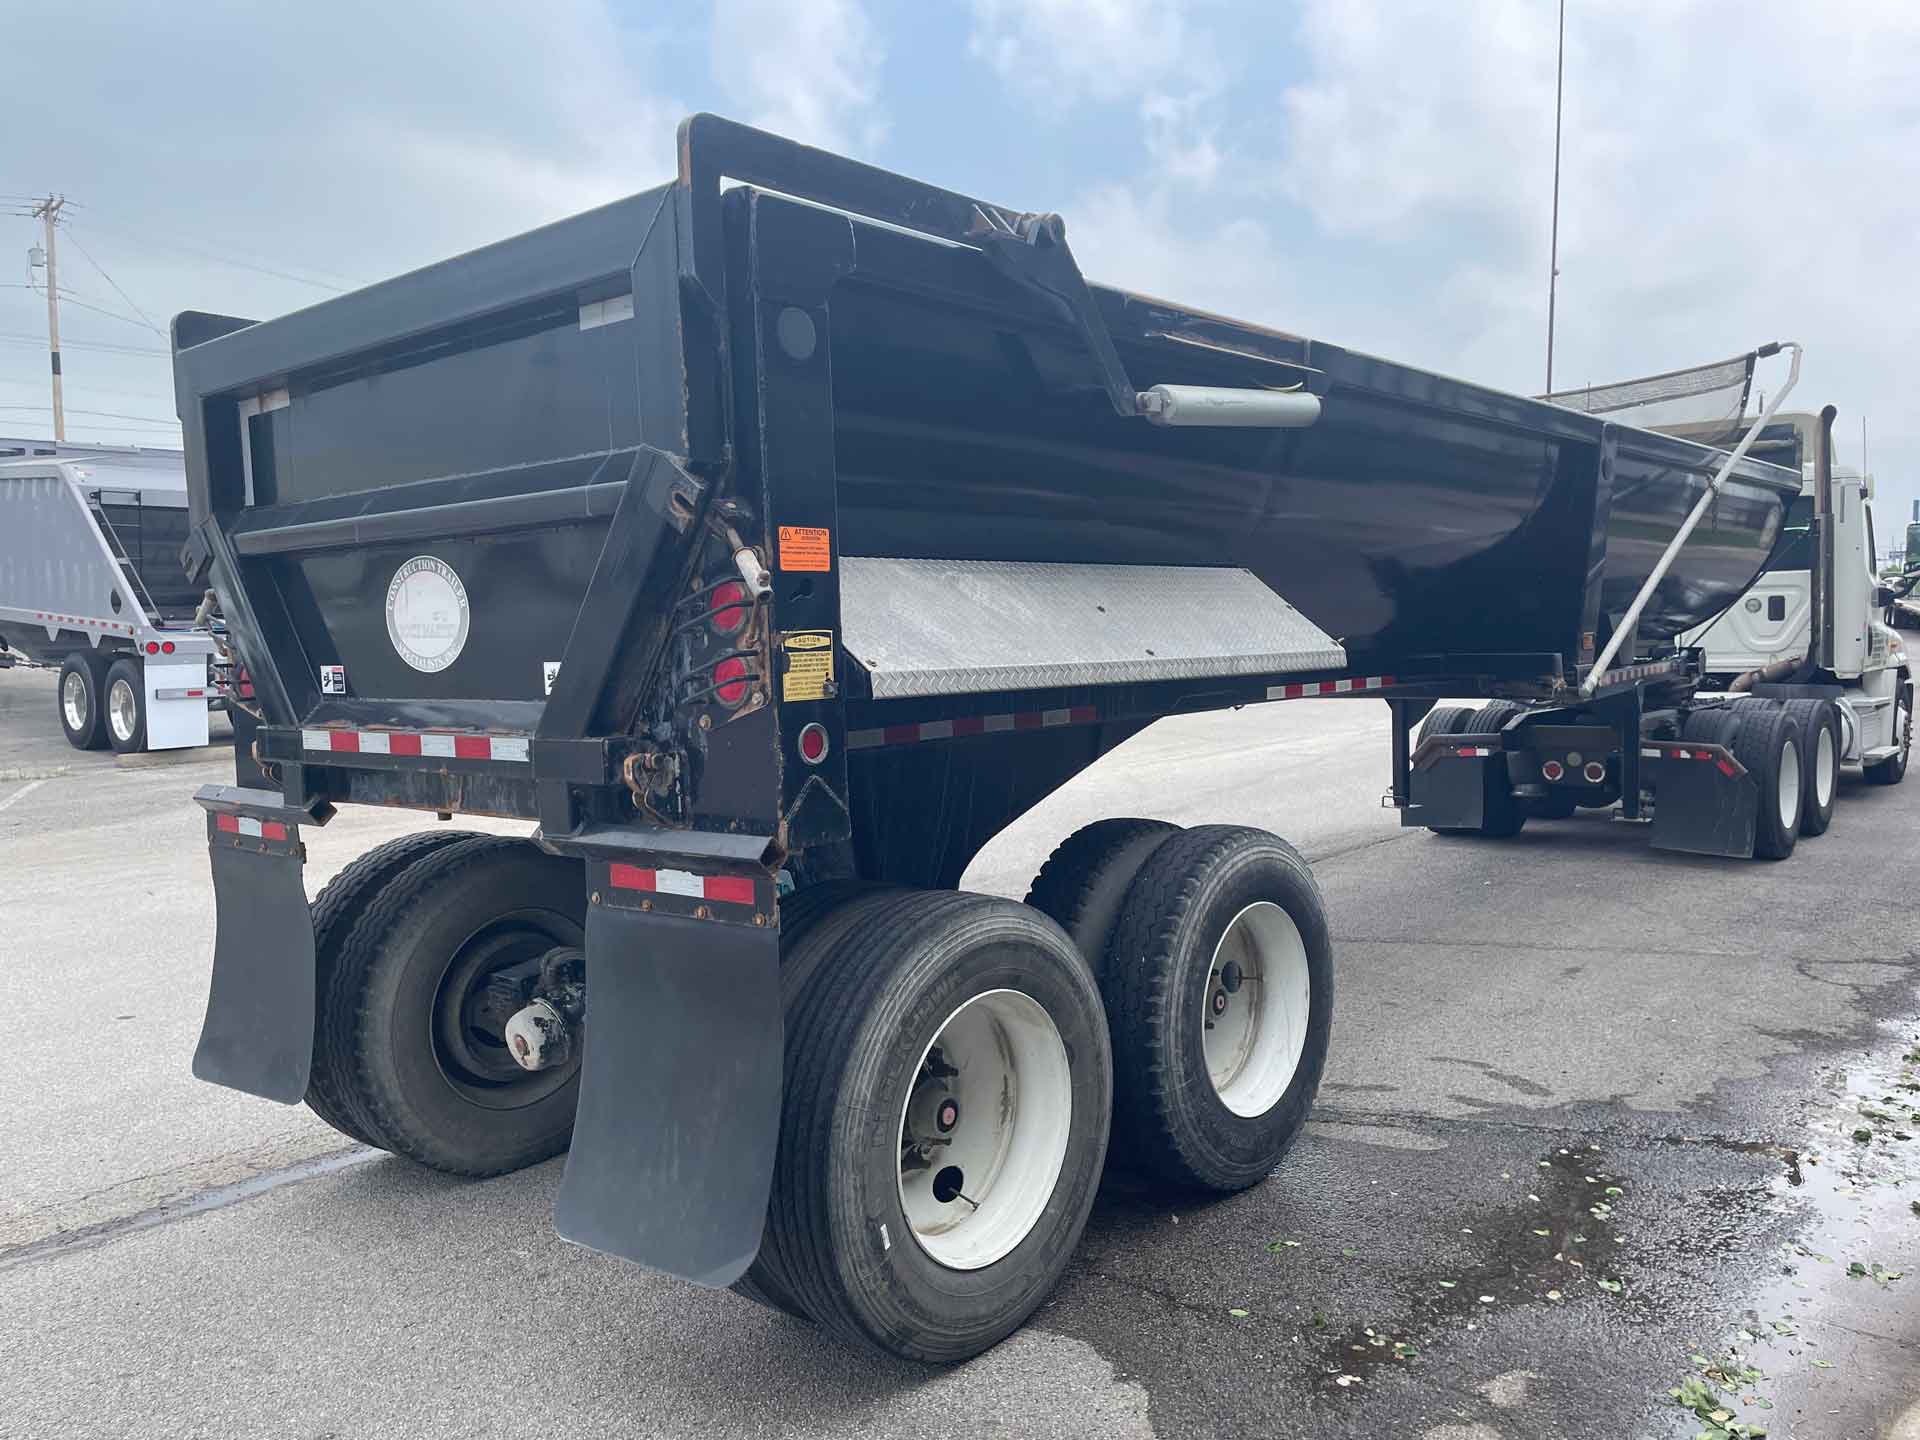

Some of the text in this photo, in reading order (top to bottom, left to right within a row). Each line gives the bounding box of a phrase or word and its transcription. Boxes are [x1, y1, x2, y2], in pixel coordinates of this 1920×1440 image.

[794, 528, 827, 537] ATTENTION
[387, 559, 468, 611] CONSTRUCTION TRAILER
[794, 636, 821, 644] CAUTION
